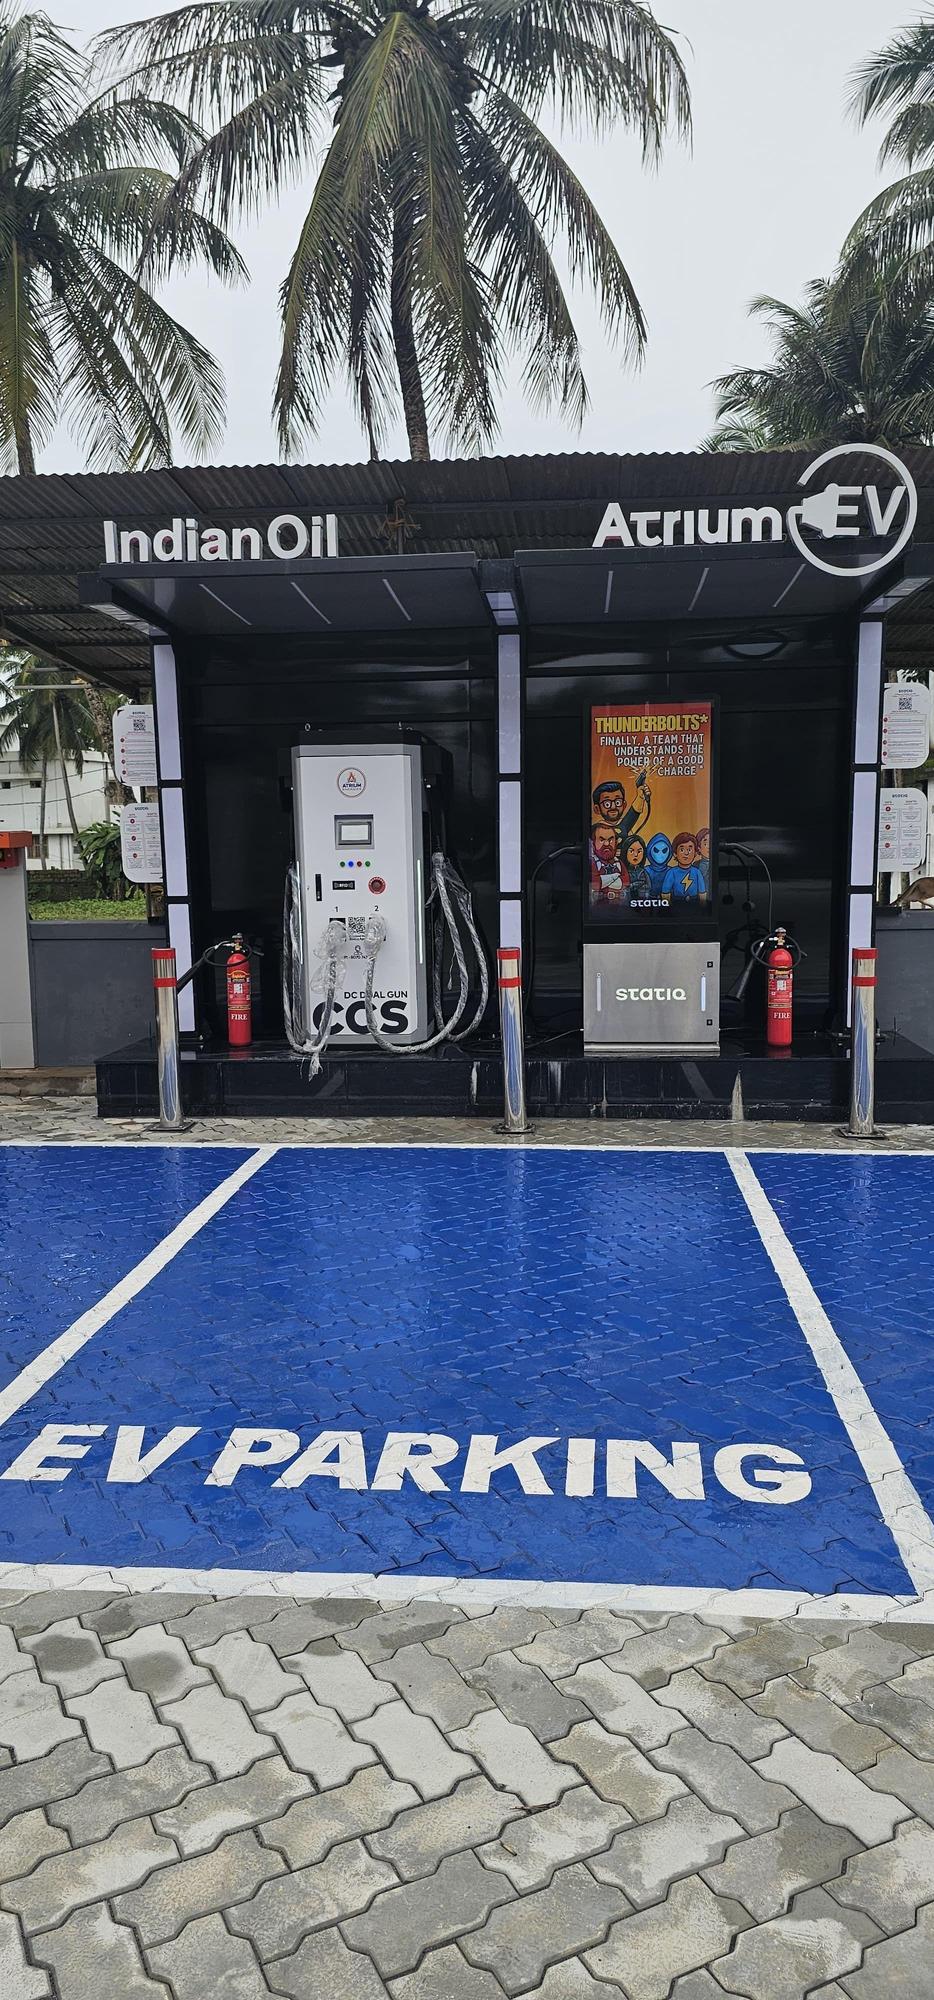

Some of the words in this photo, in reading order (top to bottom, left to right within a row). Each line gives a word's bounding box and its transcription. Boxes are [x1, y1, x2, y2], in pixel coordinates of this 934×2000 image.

[592, 502, 783, 548] Atrium
[827, 485, 907, 536] EV
[600, 735, 641, 746] FINALLY,
[643, 735, 650, 745] A
[652, 734, 678, 745] TEAM
[680, 733, 705, 743] THAT
[614, 745, 683, 756] UNDERSTANDS
[686, 744, 704, 754] THE
[617, 757, 650, 767] POWER
[652, 756, 665, 766] OF
[667, 756, 674, 765] A
[677, 755, 704, 765] GOOD
[344, 990, 358, 1000] DC
[359, 990, 386, 1000] DAL
[387, 990, 408, 999] GUN
[231, 1013, 248, 1021] FIRE
[312, 1000, 409, 1036] CCS
[0, 1423, 203, 1483] EV
[204, 1426, 812, 1504] PARKING
